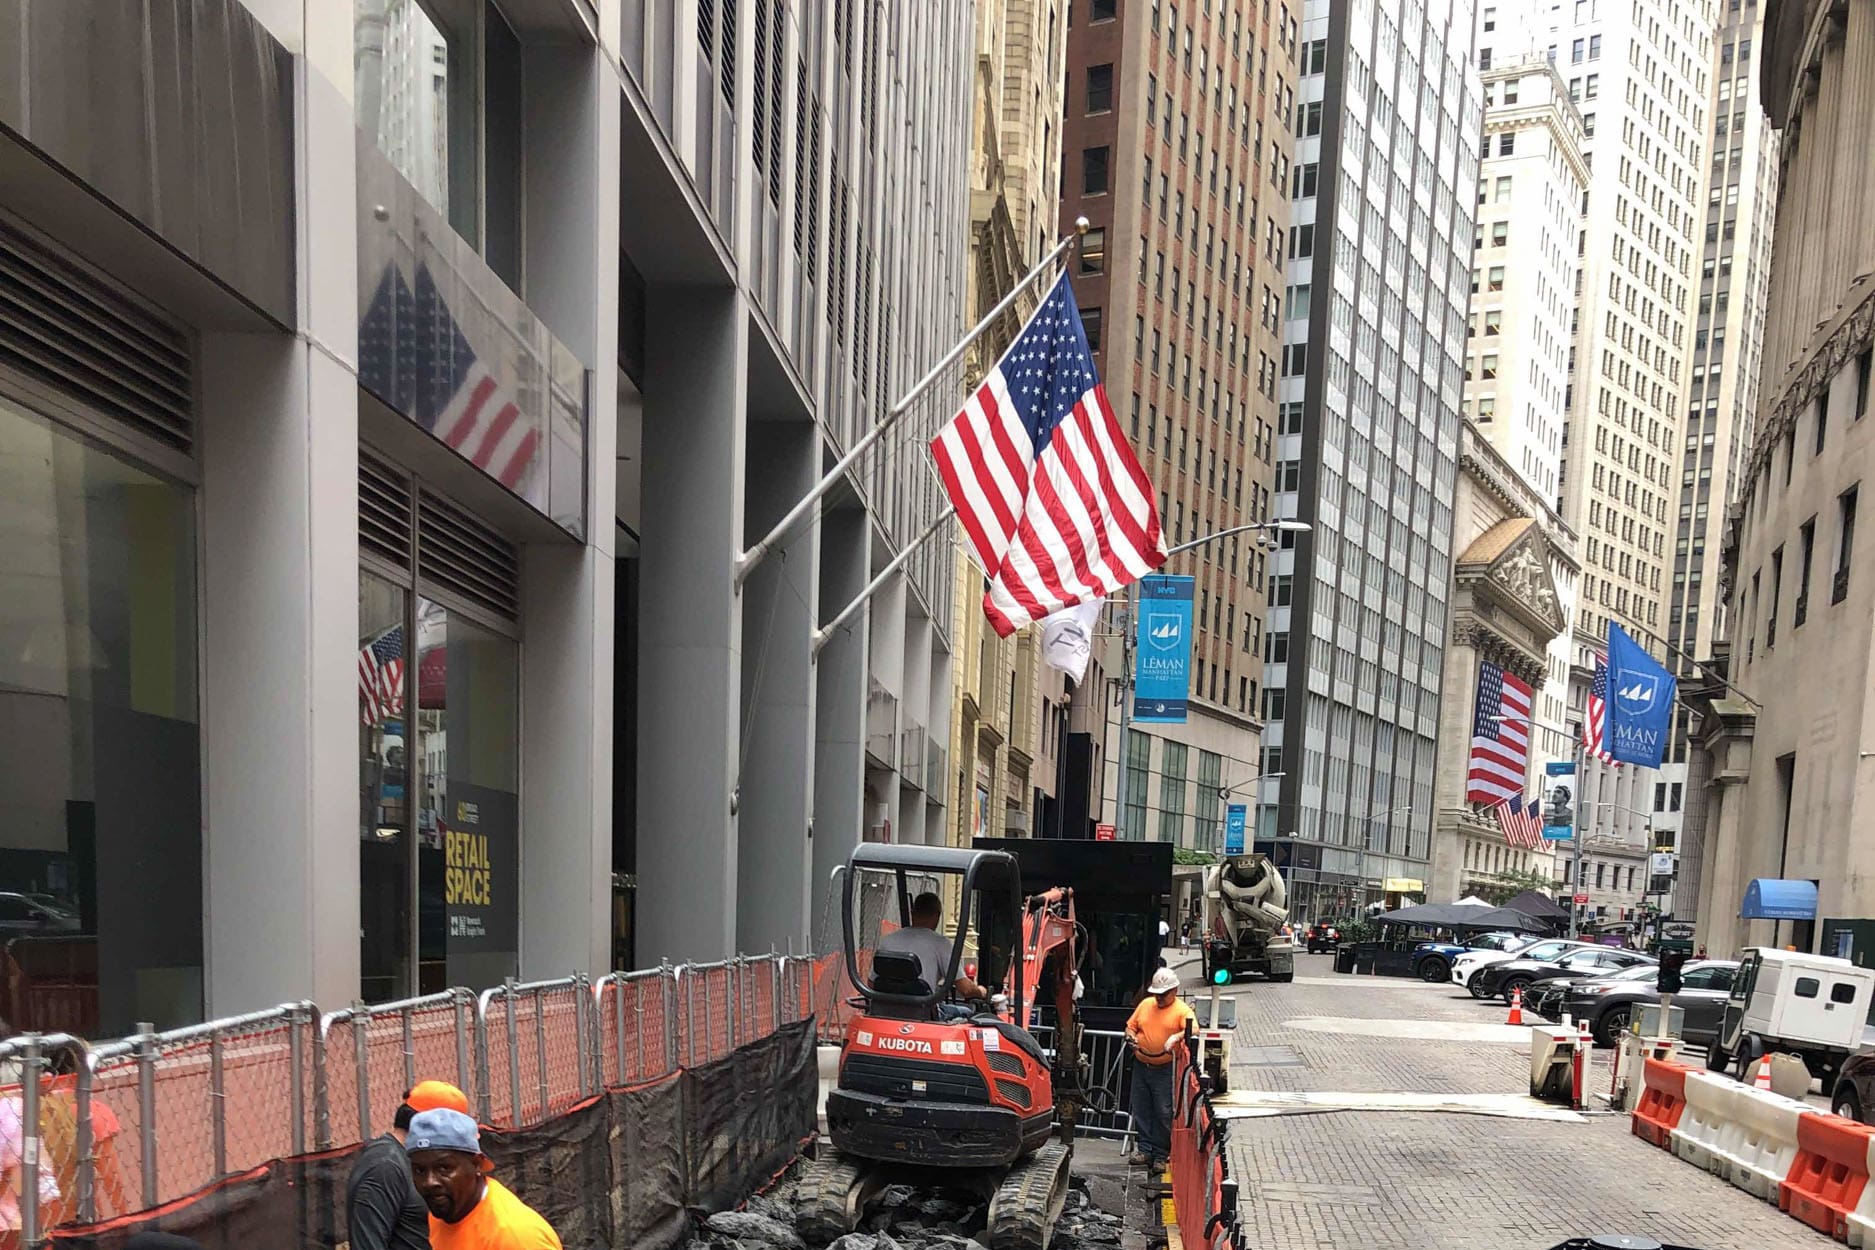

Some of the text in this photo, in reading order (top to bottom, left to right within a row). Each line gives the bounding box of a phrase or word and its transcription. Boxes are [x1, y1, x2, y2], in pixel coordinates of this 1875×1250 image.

[445, 830, 491, 870] RETAIL
[445, 868, 491, 906] SPACE
[878, 1037, 933, 1054] KUBOTA
